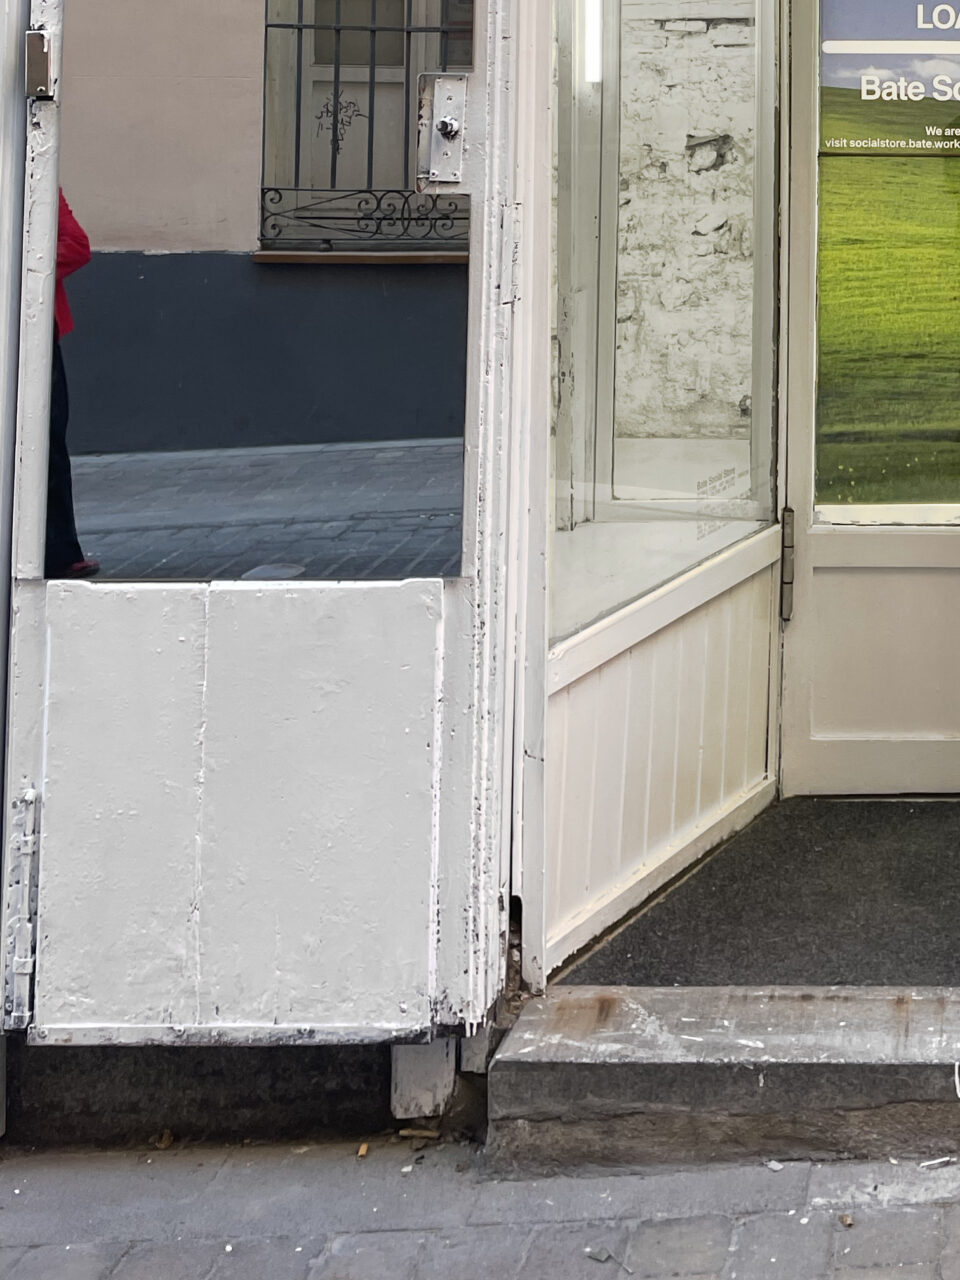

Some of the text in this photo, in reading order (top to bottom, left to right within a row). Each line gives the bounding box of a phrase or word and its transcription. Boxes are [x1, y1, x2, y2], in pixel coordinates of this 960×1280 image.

[860, 75, 925, 101] Bate
[925, 126, 942, 136] We
[944, 128, 960, 136] are
[825, 138, 847, 148] visit
[849, 138, 960, 148] socialstore.bate.work
